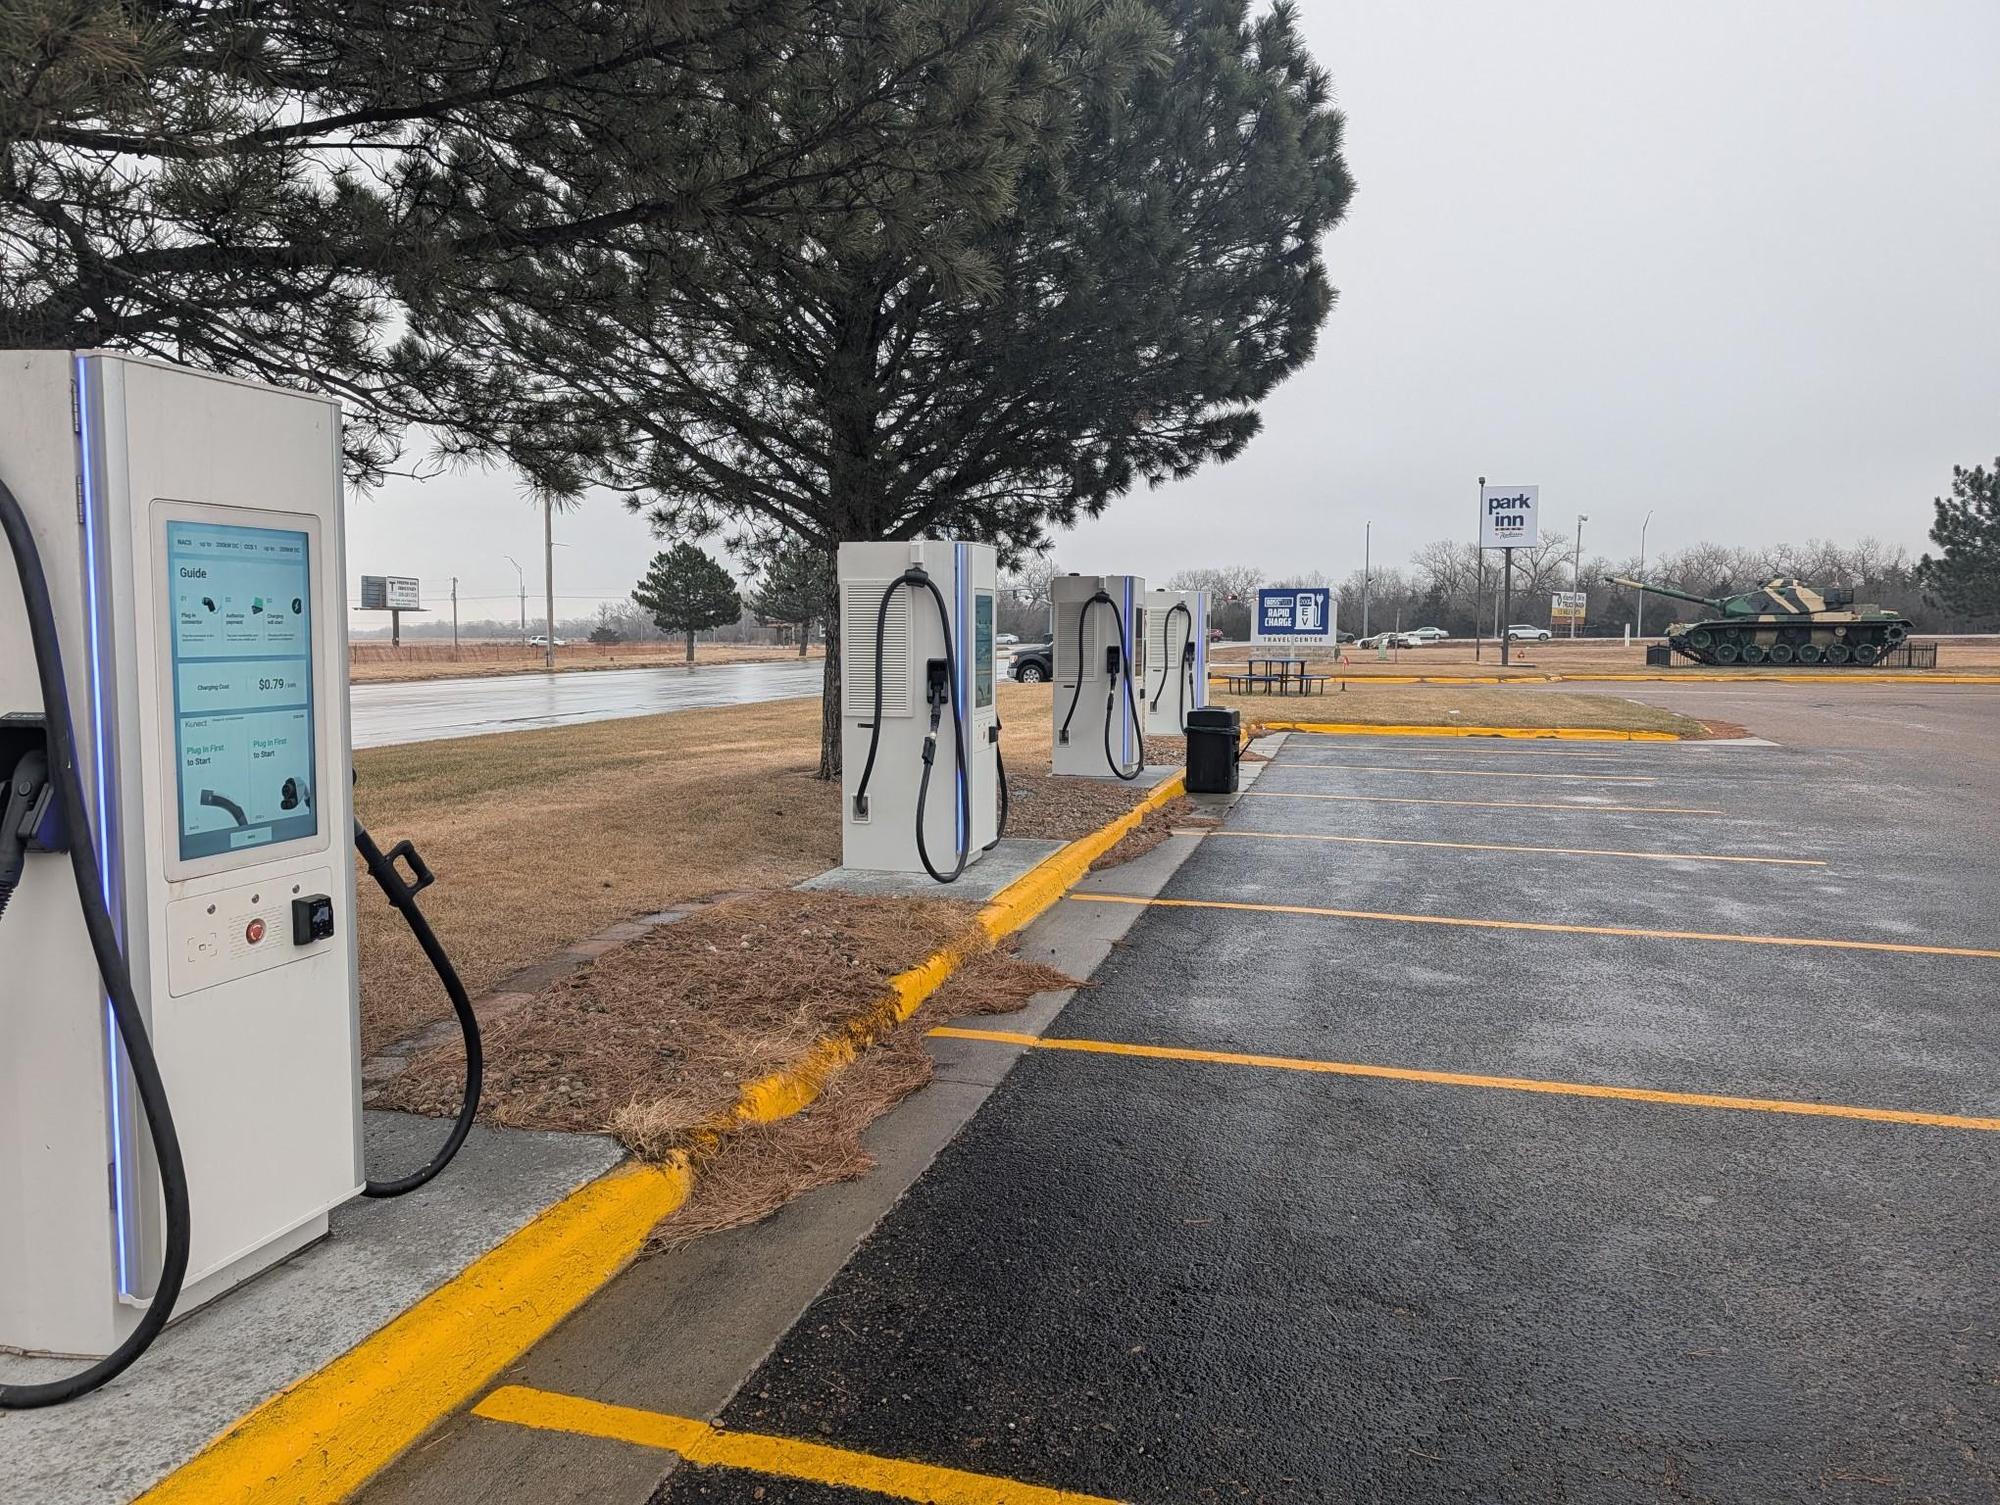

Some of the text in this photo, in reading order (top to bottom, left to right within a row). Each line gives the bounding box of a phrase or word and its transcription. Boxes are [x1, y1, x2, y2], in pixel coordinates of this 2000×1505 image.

[1489, 494, 1531, 515] park
[1495, 512, 1524, 527] inn
[180, 567, 207, 579] Guide
[181, 612, 189, 620] Plug
[1267, 608, 1290, 617] RAPID
[1264, 618, 1292, 627] CHARGE
[258, 678, 284, 691] $0.79
[253, 740, 267, 749] Plug
[187, 745, 201, 755] Plug
[210, 744, 224, 752] First
[260, 750, 275, 758] Start
[195, 757, 211, 766] Start
